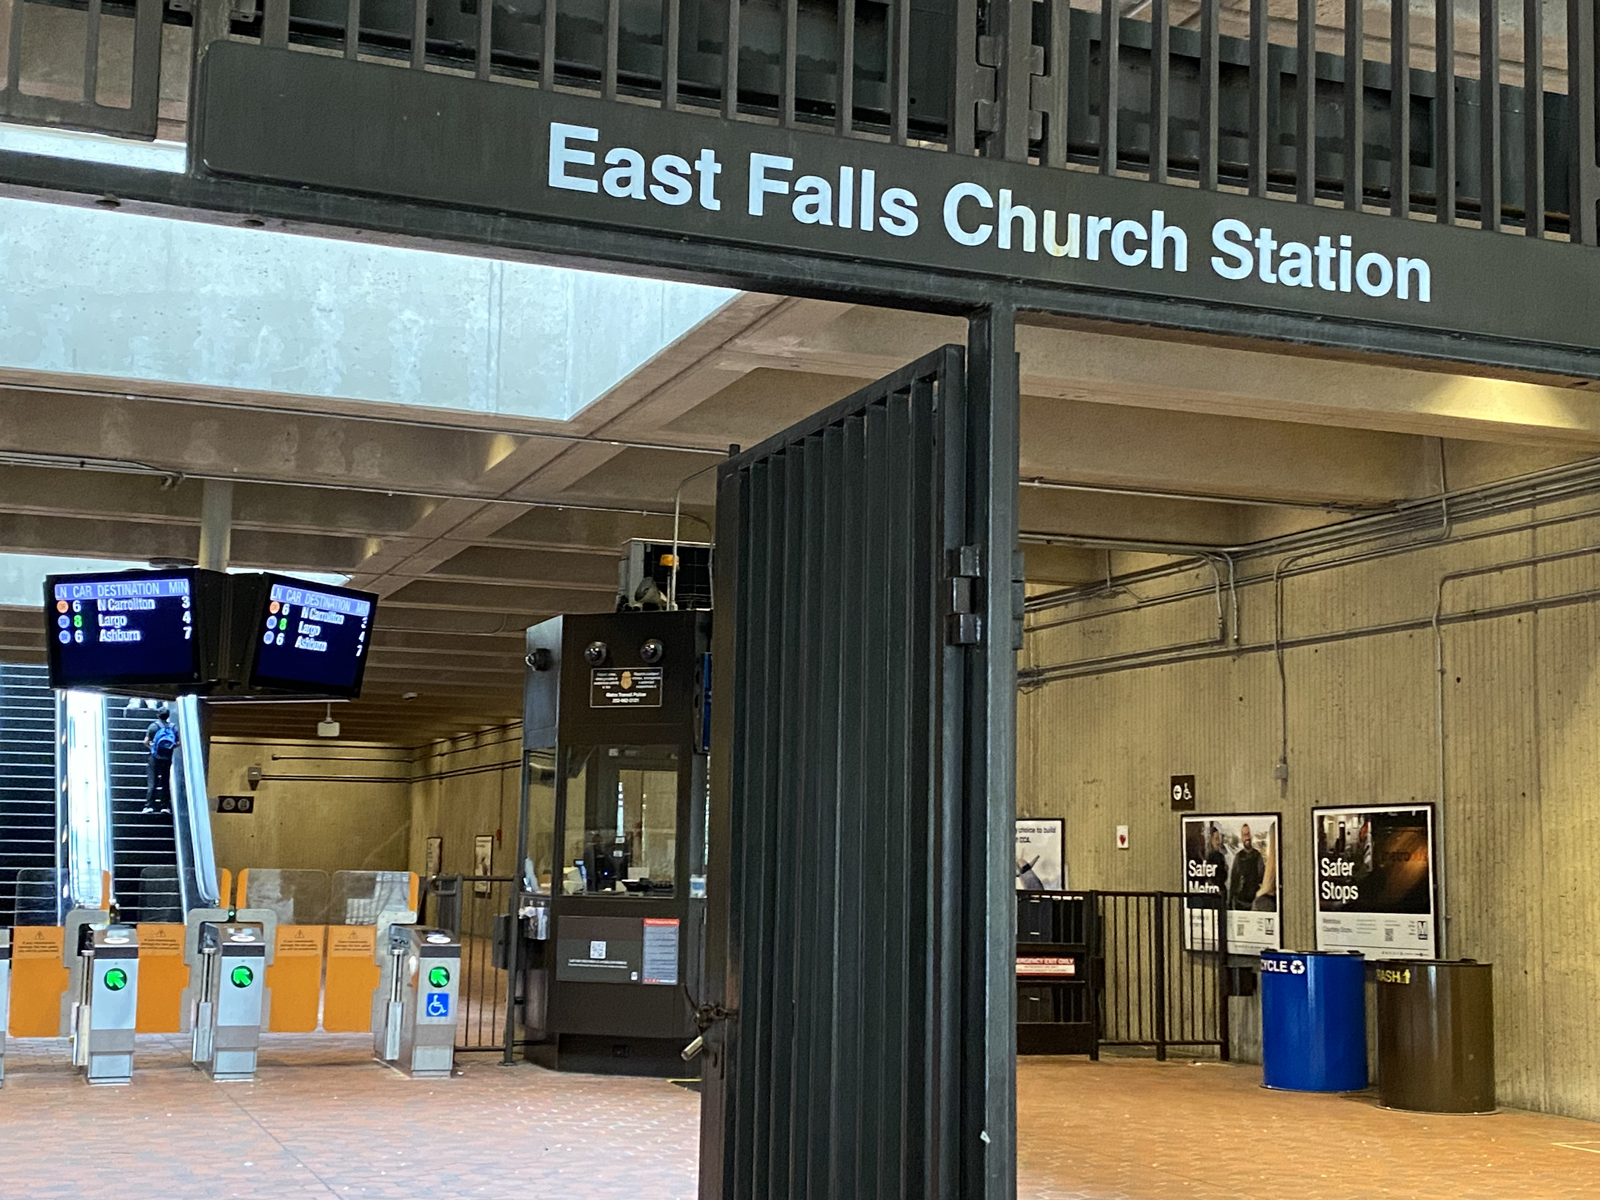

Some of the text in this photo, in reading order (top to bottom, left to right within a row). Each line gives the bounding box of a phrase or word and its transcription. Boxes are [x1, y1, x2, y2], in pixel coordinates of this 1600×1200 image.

[548, 121, 1431, 303] East Falls Church Station
[73, 585, 92, 598] CAR
[97, 582, 160, 597] DESTINATION
[168, 581, 188, 594] MIN
[72, 600, 81, 613] 6
[97, 599, 107, 611] N
[107, 598, 156, 611] Carrollton
[181, 596, 191, 608] 3
[286, 589, 302, 604] CAR
[304, 593, 352, 612] DESTINATION
[281, 603, 290, 616] 6
[73, 615, 82, 628] 8
[98, 613, 128, 628] Largo
[182, 611, 192, 624] 4
[279, 617, 288, 631] 8
[298, 620, 321, 637] Largo
[74, 629, 84, 643] 6
[99, 628, 141, 642] Ashburn
[182, 626, 192, 640] 7
[276, 632, 285, 646] 6
[1188, 859, 1218, 877] Safer
[1320, 857, 1355, 877] Safer
[1321, 880, 1359, 905] Stops
